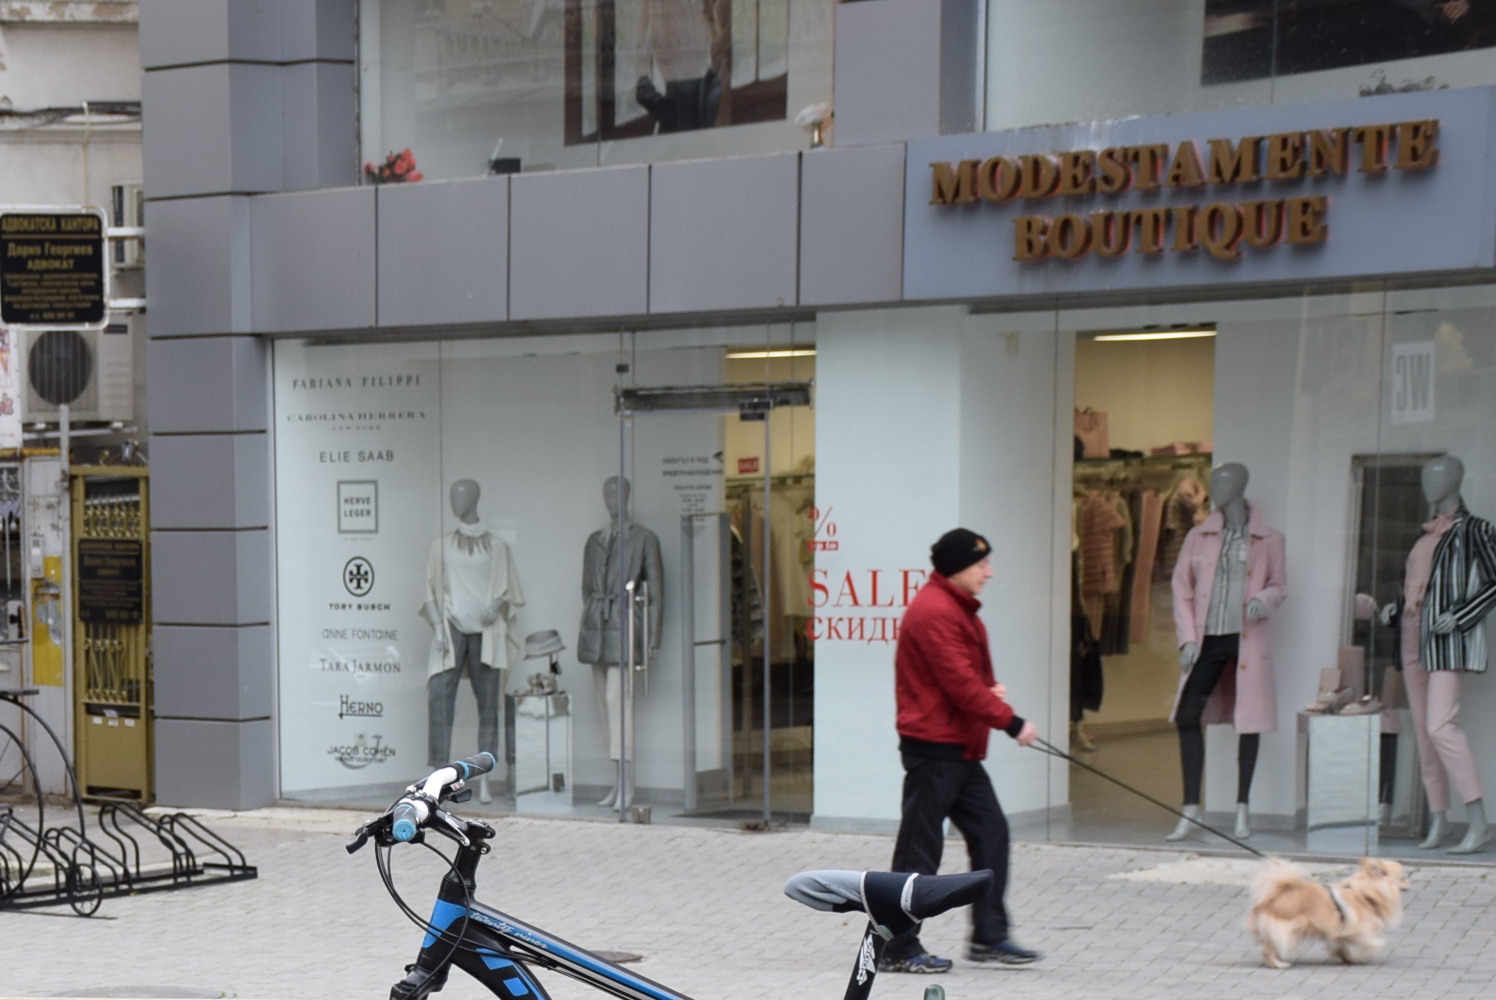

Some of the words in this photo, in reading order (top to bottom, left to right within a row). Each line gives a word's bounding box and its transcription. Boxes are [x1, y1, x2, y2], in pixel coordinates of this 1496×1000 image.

[929, 119, 1440, 206] MODESTAMENTE
[1011, 195, 1331, 262] BOUTIQUE
[26, 259, 75, 270] АДВОКАТ
[292, 377, 352, 389] FABIANA
[362, 375, 421, 388] FILIPPI
[319, 450, 351, 463] ELIE
[357, 449, 395, 463] SAAB
[329, 603, 353, 611] TORY
[357, 603, 391, 611] BURCH
